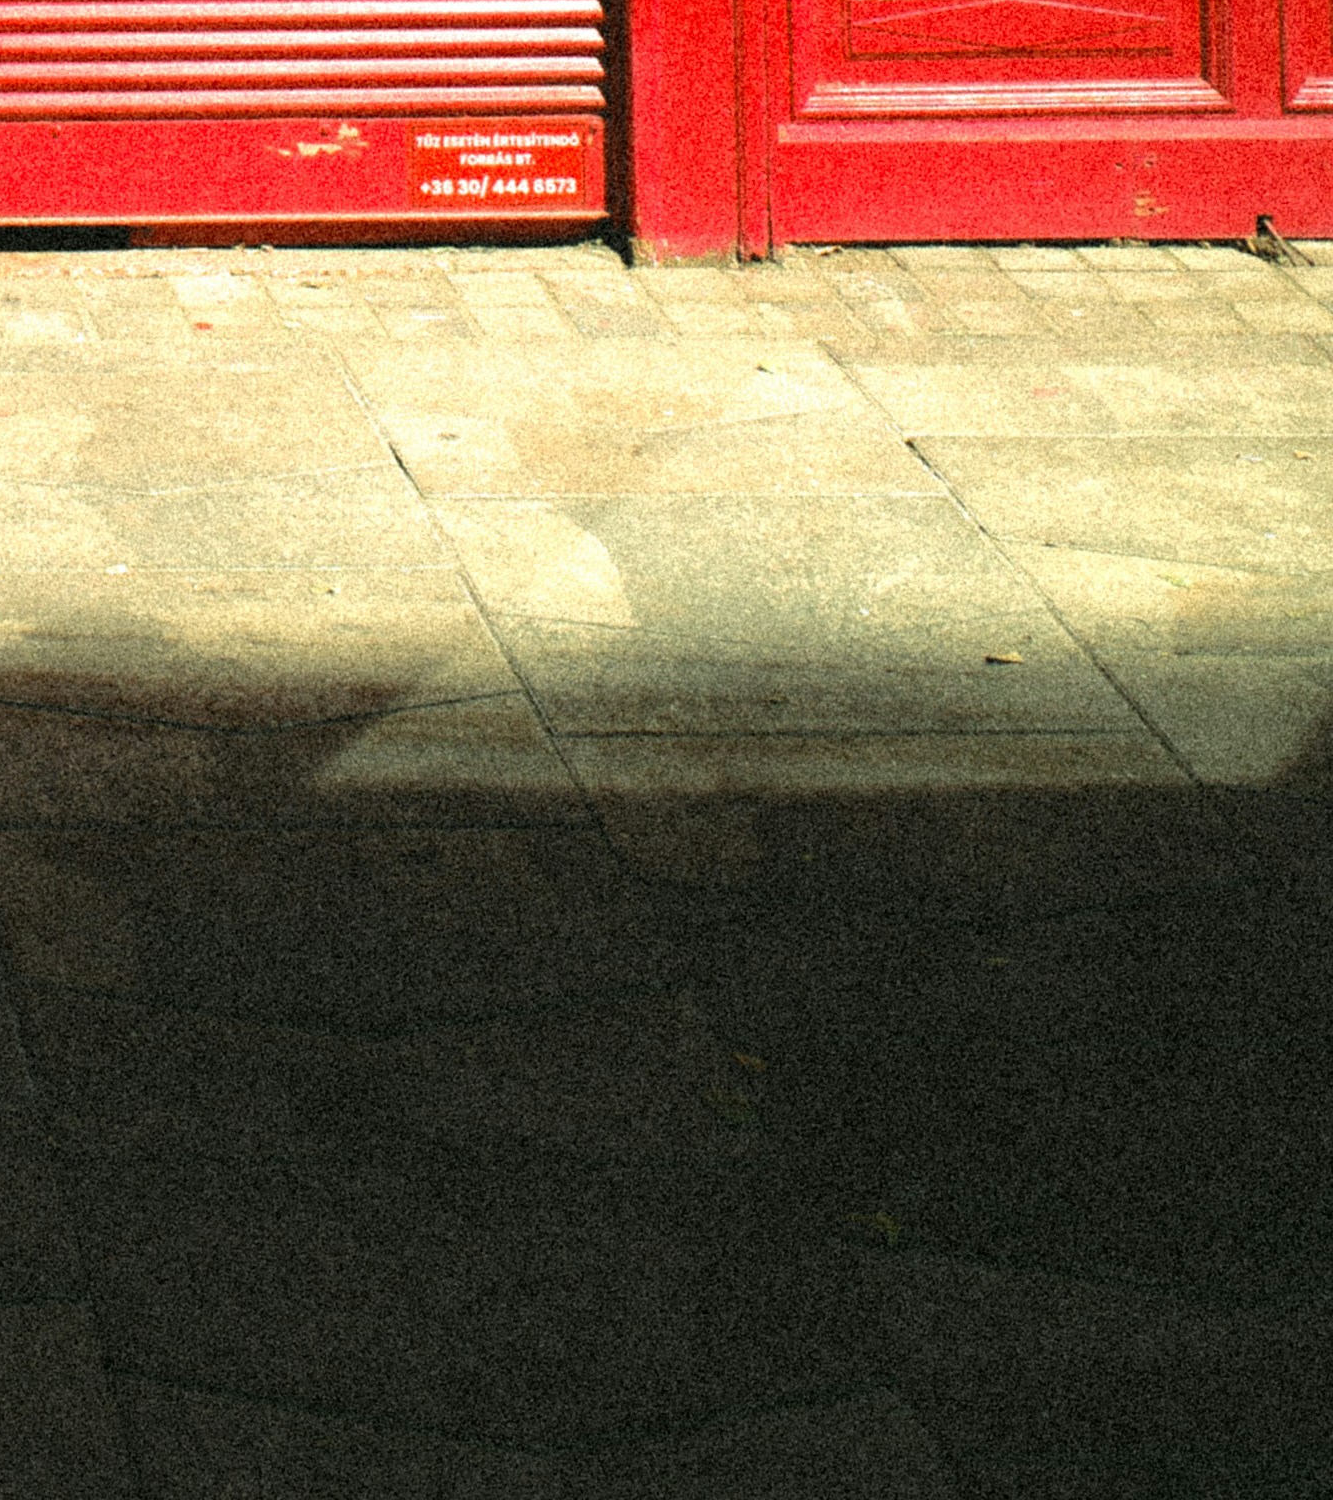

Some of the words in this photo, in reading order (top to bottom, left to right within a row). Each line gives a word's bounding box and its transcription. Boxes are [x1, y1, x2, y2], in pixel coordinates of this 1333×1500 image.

[420, 179, 454, 195] +36
[458, 175, 490, 198] 30/
[492, 179, 529, 194] 444
